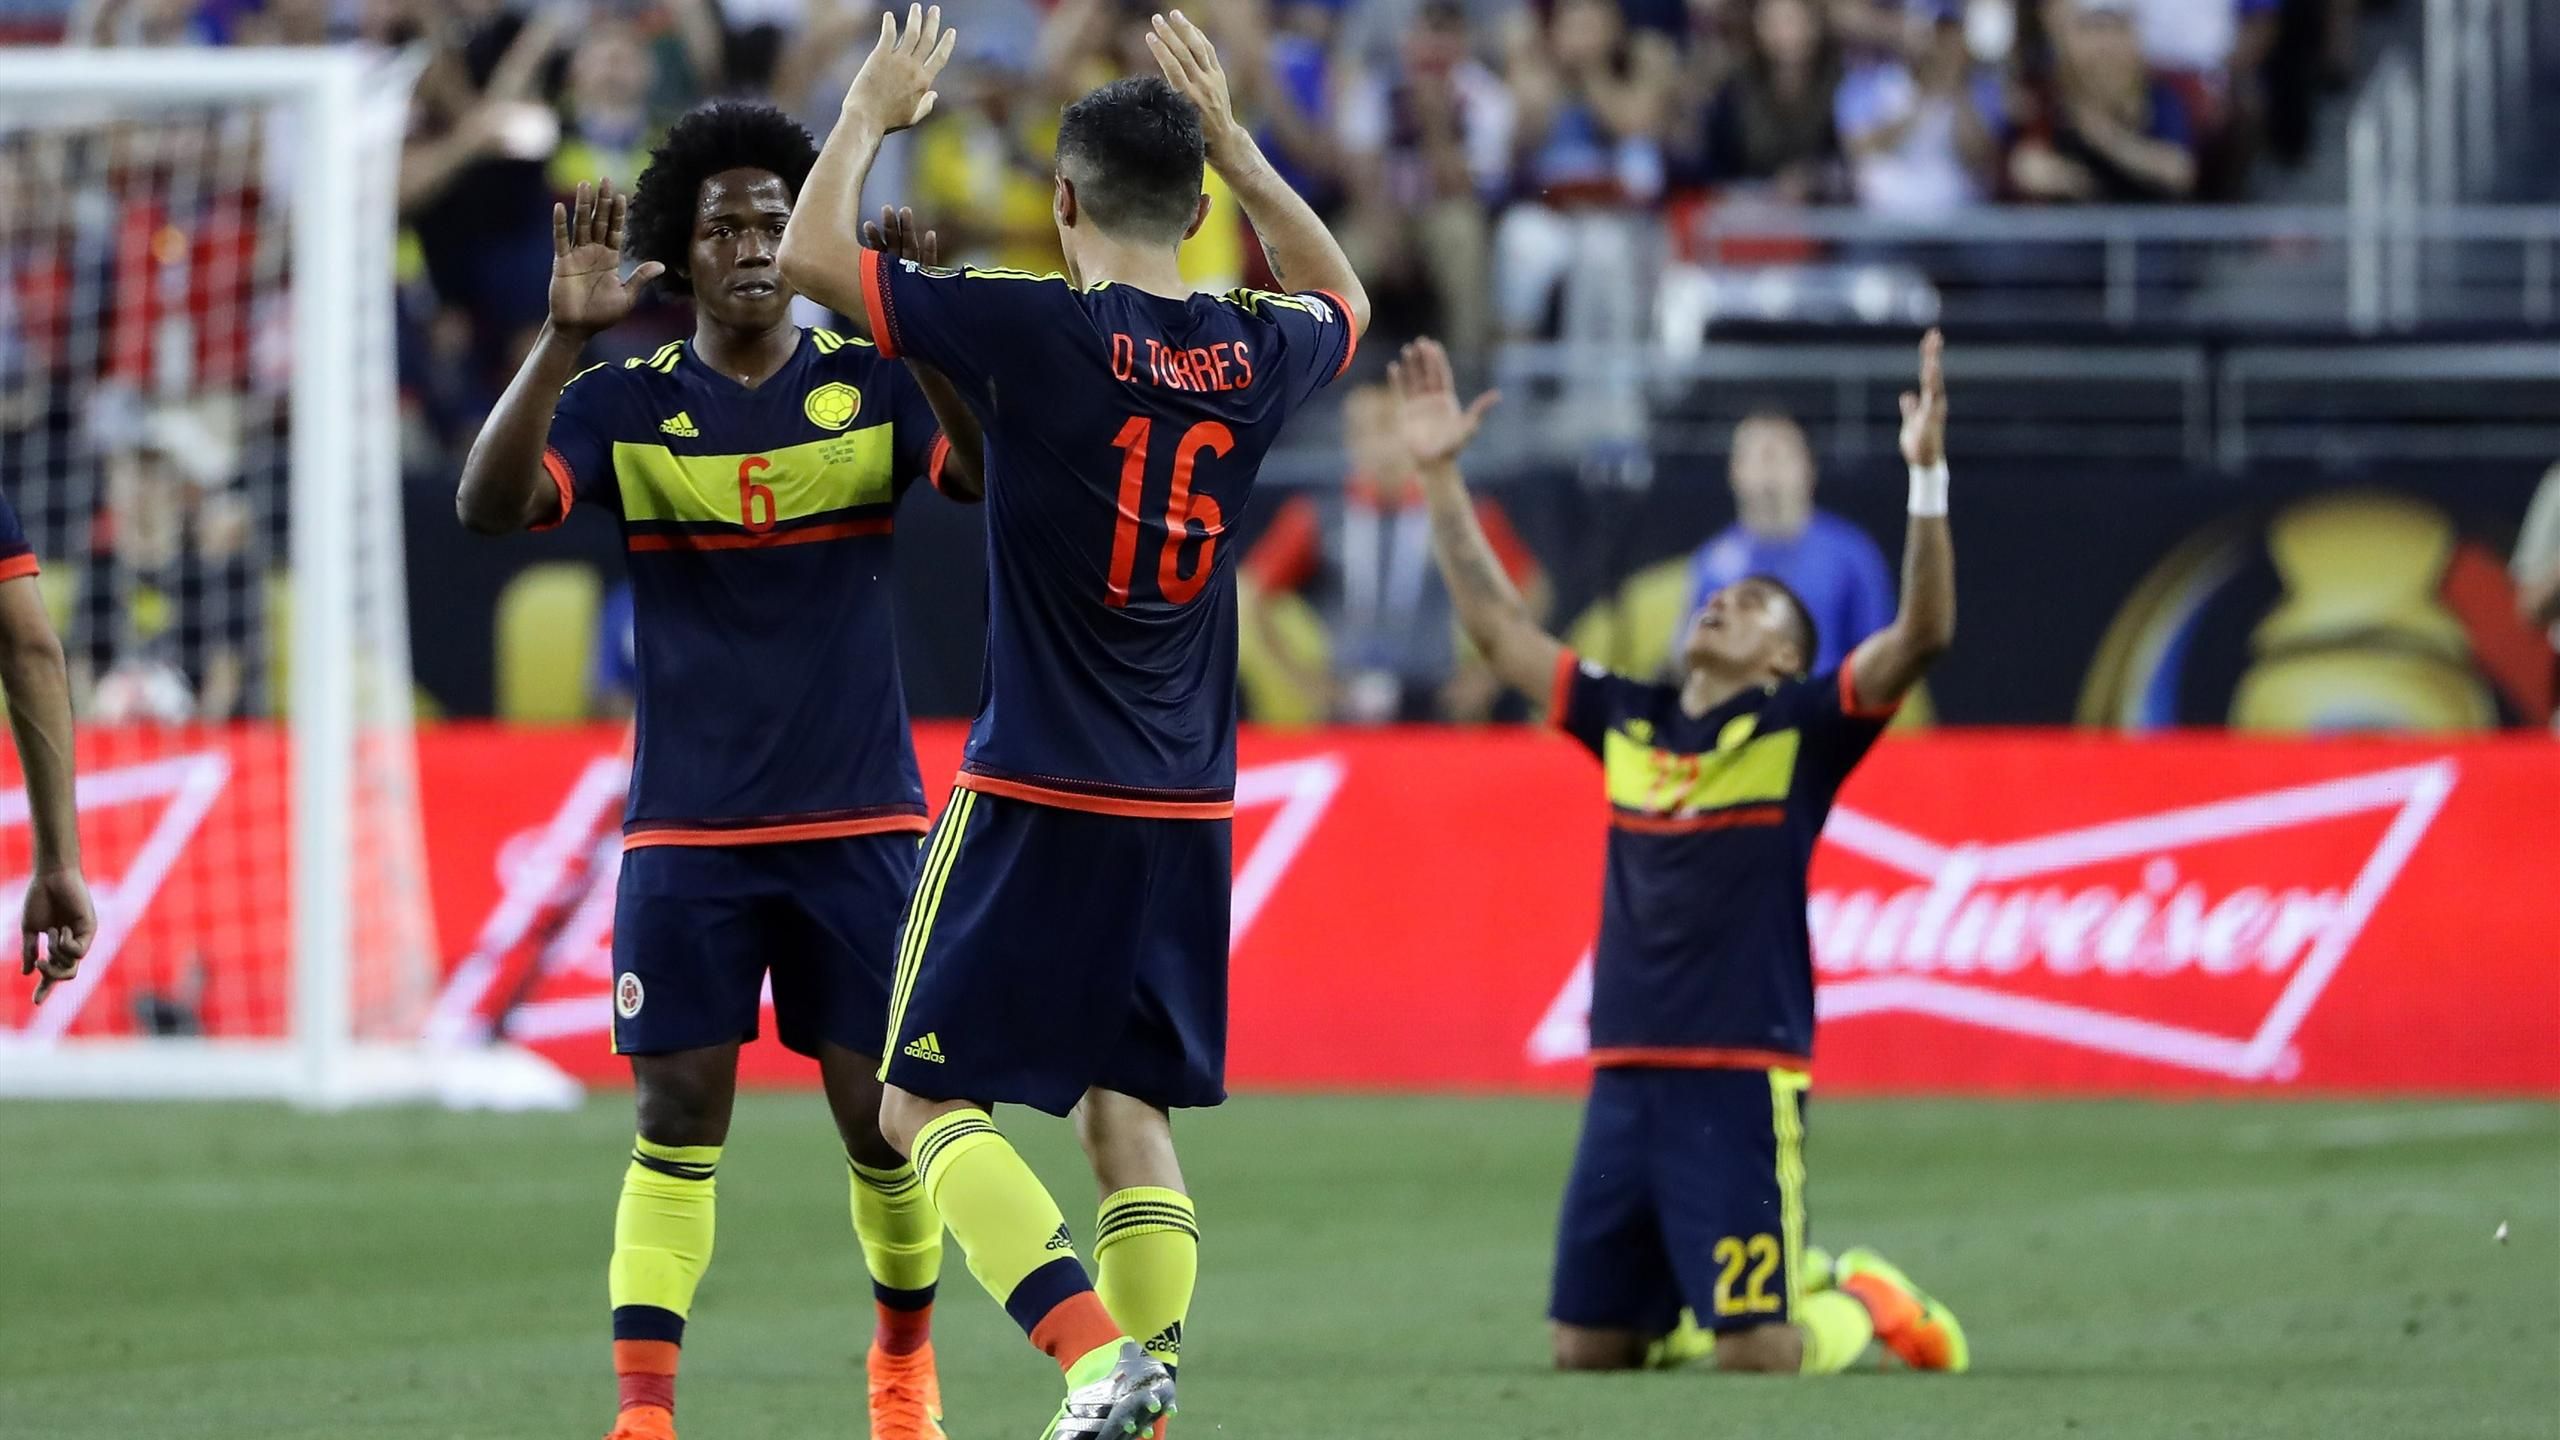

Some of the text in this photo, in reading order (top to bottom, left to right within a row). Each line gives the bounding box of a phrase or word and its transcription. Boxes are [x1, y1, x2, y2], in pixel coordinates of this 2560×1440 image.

[1112, 332, 1253, 392] D. TORRES
[659, 423, 700, 438] adidas
[738, 455, 777, 534] 6
[1104, 415, 1236, 608] 16
[1806, 840, 2348, 976] udweiser
[903, 1045, 946, 1064] adidas
[1713, 1233, 1781, 1316] 22
